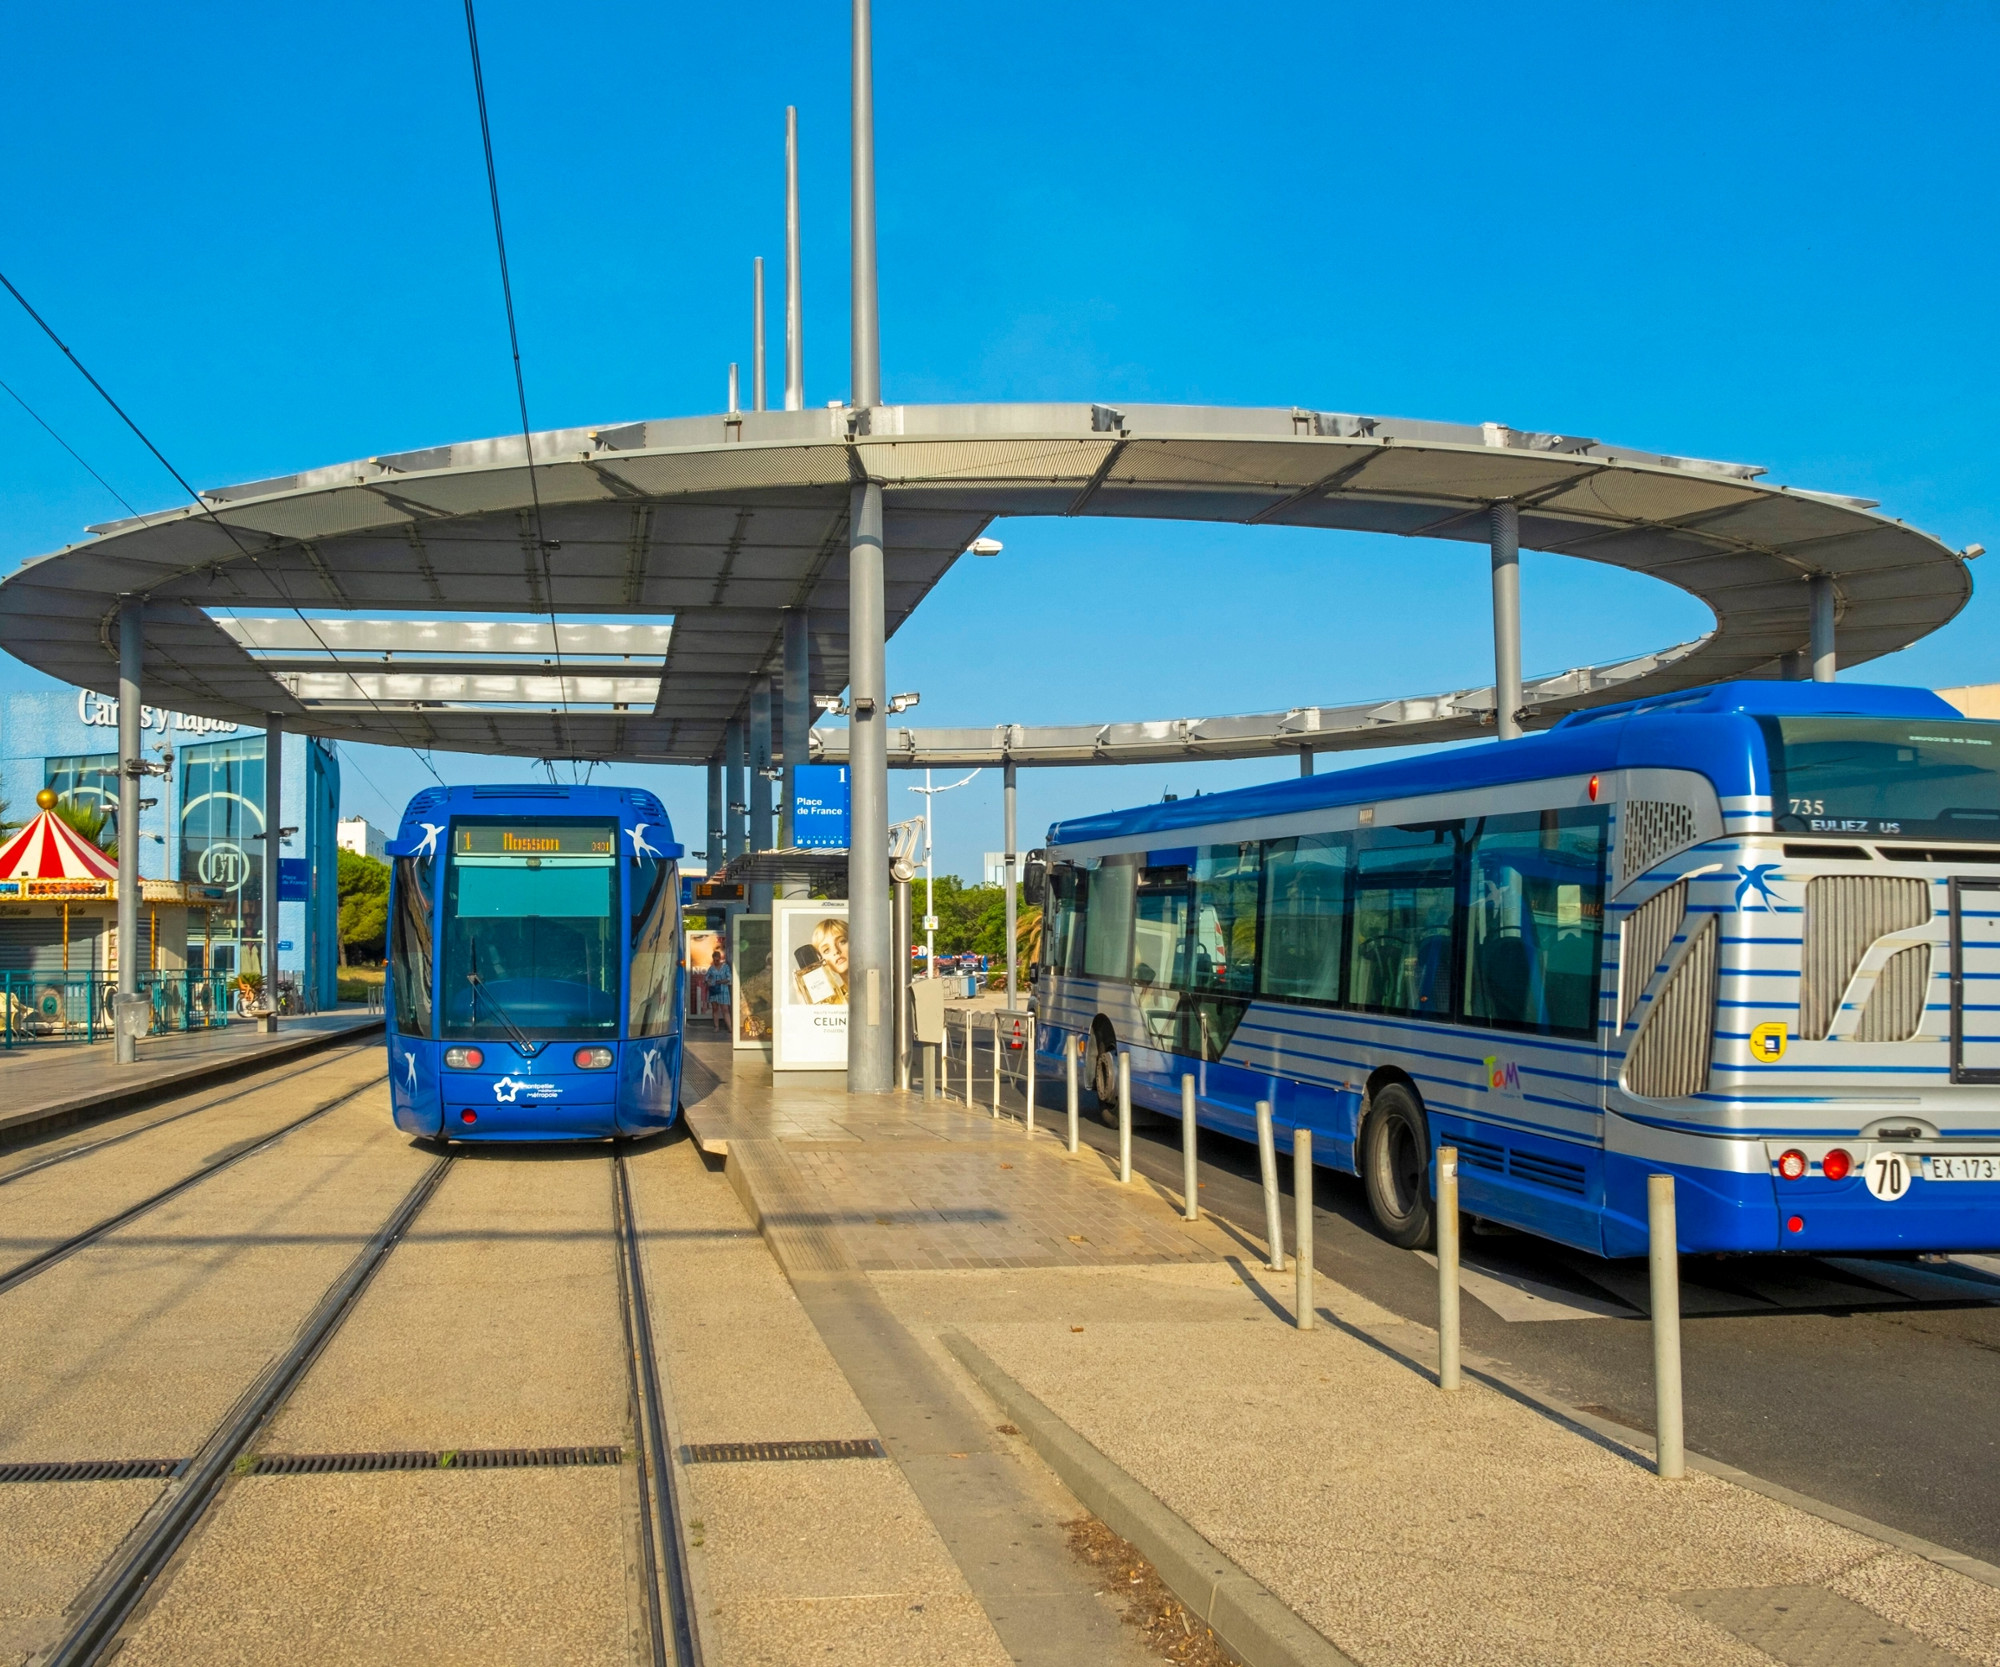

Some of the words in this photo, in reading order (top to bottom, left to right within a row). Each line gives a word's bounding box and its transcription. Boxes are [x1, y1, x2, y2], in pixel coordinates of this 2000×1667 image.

[838, 767, 847, 783] 1
[796, 797, 823, 806] Place
[1789, 799, 1825, 816] 735
[796, 807, 809, 815] de
[811, 807, 843, 815] France
[1810, 819, 1869, 833] EULIEZ
[1879, 822, 1901, 834] US
[463, 832, 472, 850] 1
[503, 832, 559, 850] Mosson
[814, 1017, 847, 1026] CELIN
[1876, 1159, 1901, 1194] 70
[1932, 1159, 2000, 1179] EX-173-
